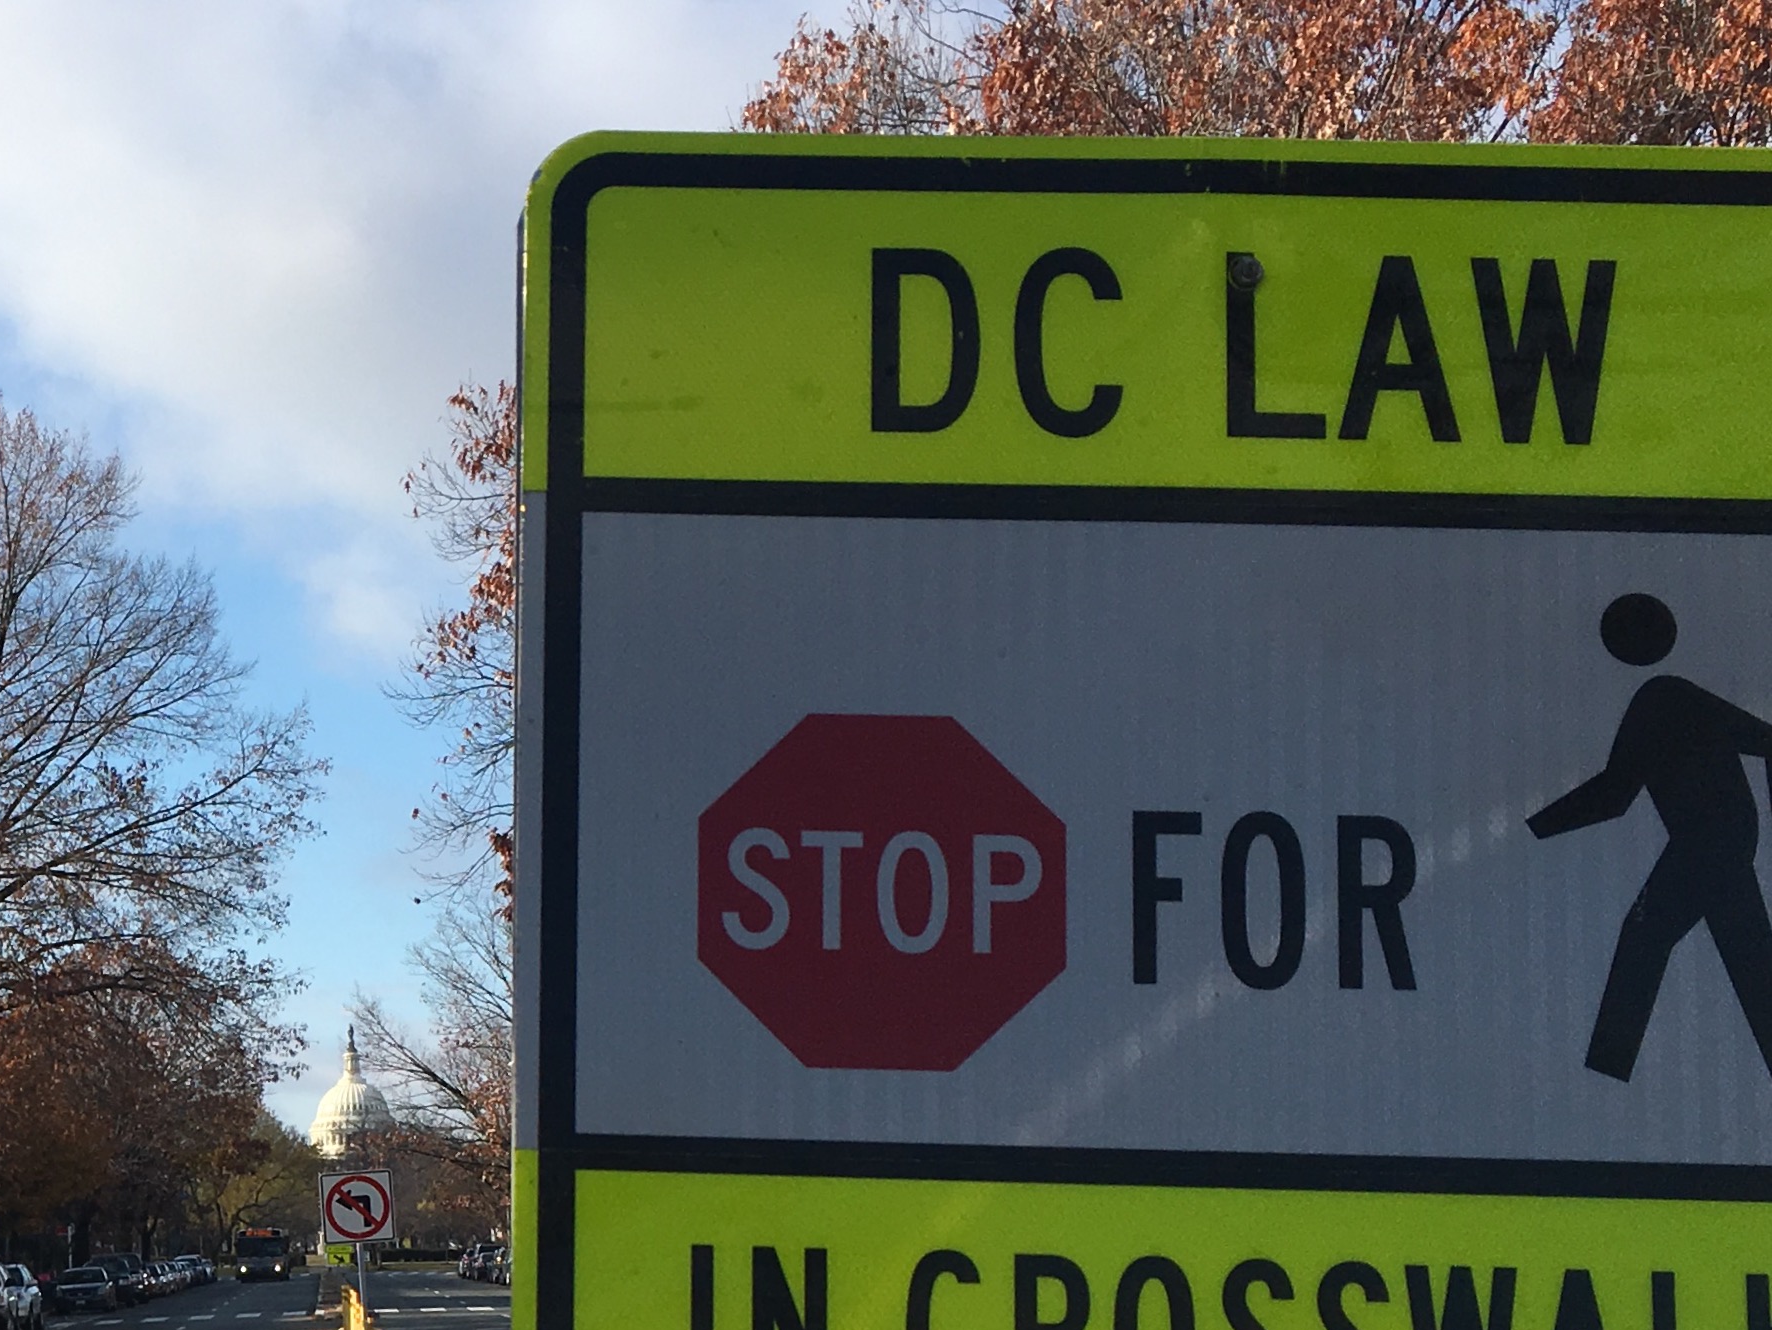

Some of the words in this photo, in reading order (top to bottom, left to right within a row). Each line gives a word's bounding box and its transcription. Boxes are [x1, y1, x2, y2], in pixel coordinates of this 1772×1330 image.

[870, 247, 1124, 439] DC
[1225, 251, 1618, 446] LAW
[722, 830, 1043, 953] STOP
[1131, 809, 1418, 992] FOR
